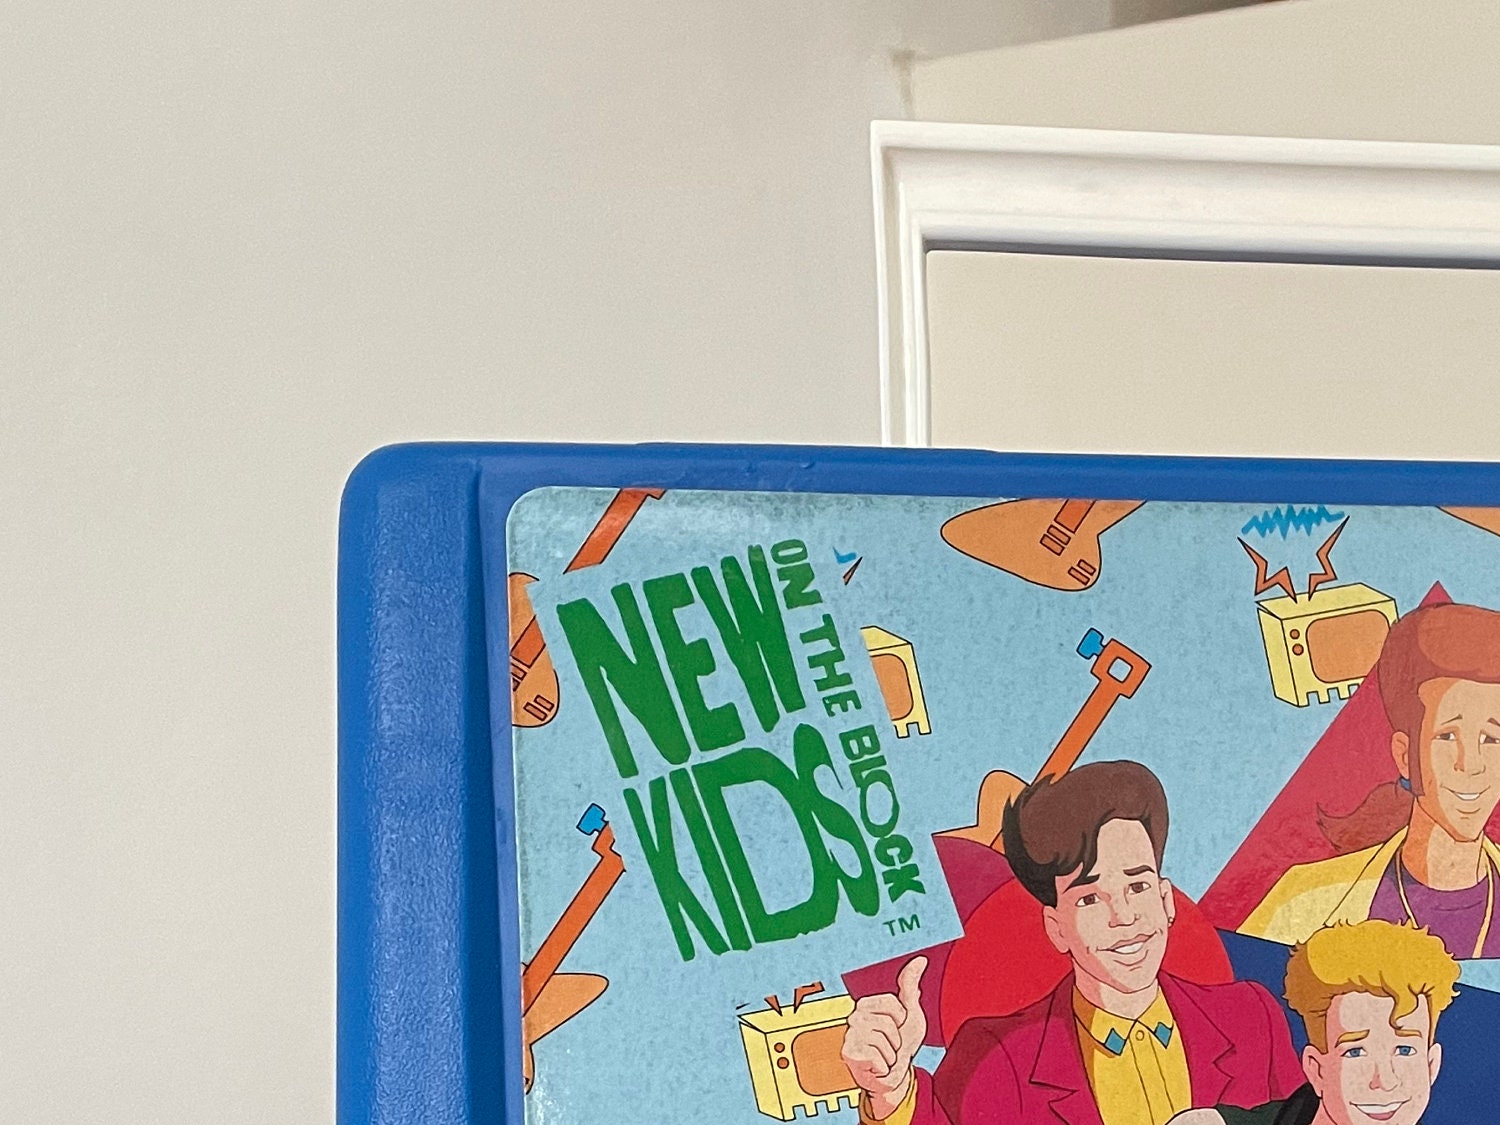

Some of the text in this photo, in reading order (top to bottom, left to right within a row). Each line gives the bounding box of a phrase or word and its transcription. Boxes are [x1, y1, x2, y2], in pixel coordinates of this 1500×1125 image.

[556, 544, 806, 779] NEW
[770, 538, 926, 903] ON THE BLOCK
[622, 722, 881, 962] KIDS
[884, 914, 921, 937] TM
